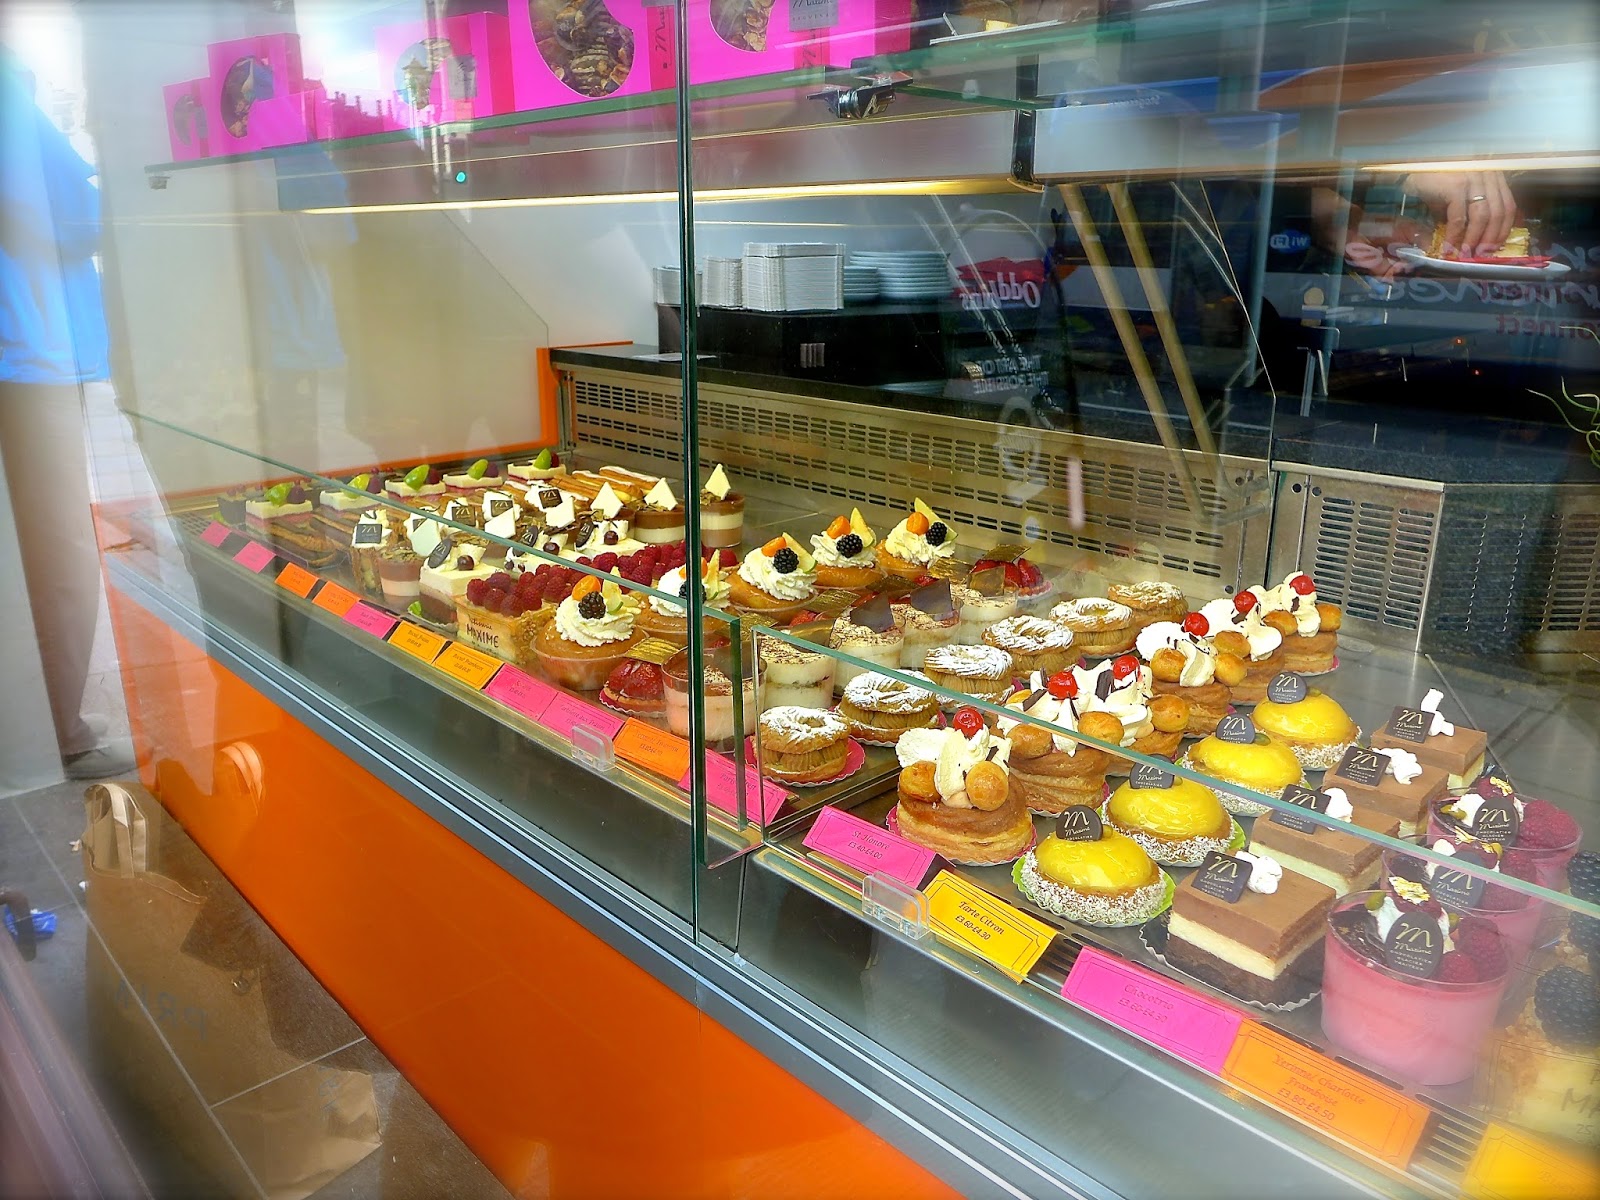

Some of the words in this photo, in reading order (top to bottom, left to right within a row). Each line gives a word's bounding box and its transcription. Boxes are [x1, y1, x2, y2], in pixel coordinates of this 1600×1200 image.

[466, 623, 500, 649] MAXIME
[955, 915, 991, 941] £3.60-£4.30
[958, 901, 980, 918] Tarte
[980, 915, 1005, 935] Citron
[1124, 984, 1174, 1011] Chocotrio
[1285, 1076, 1338, 1106] Framboise
[1318, 1077, 1366, 1105] Charlotte
